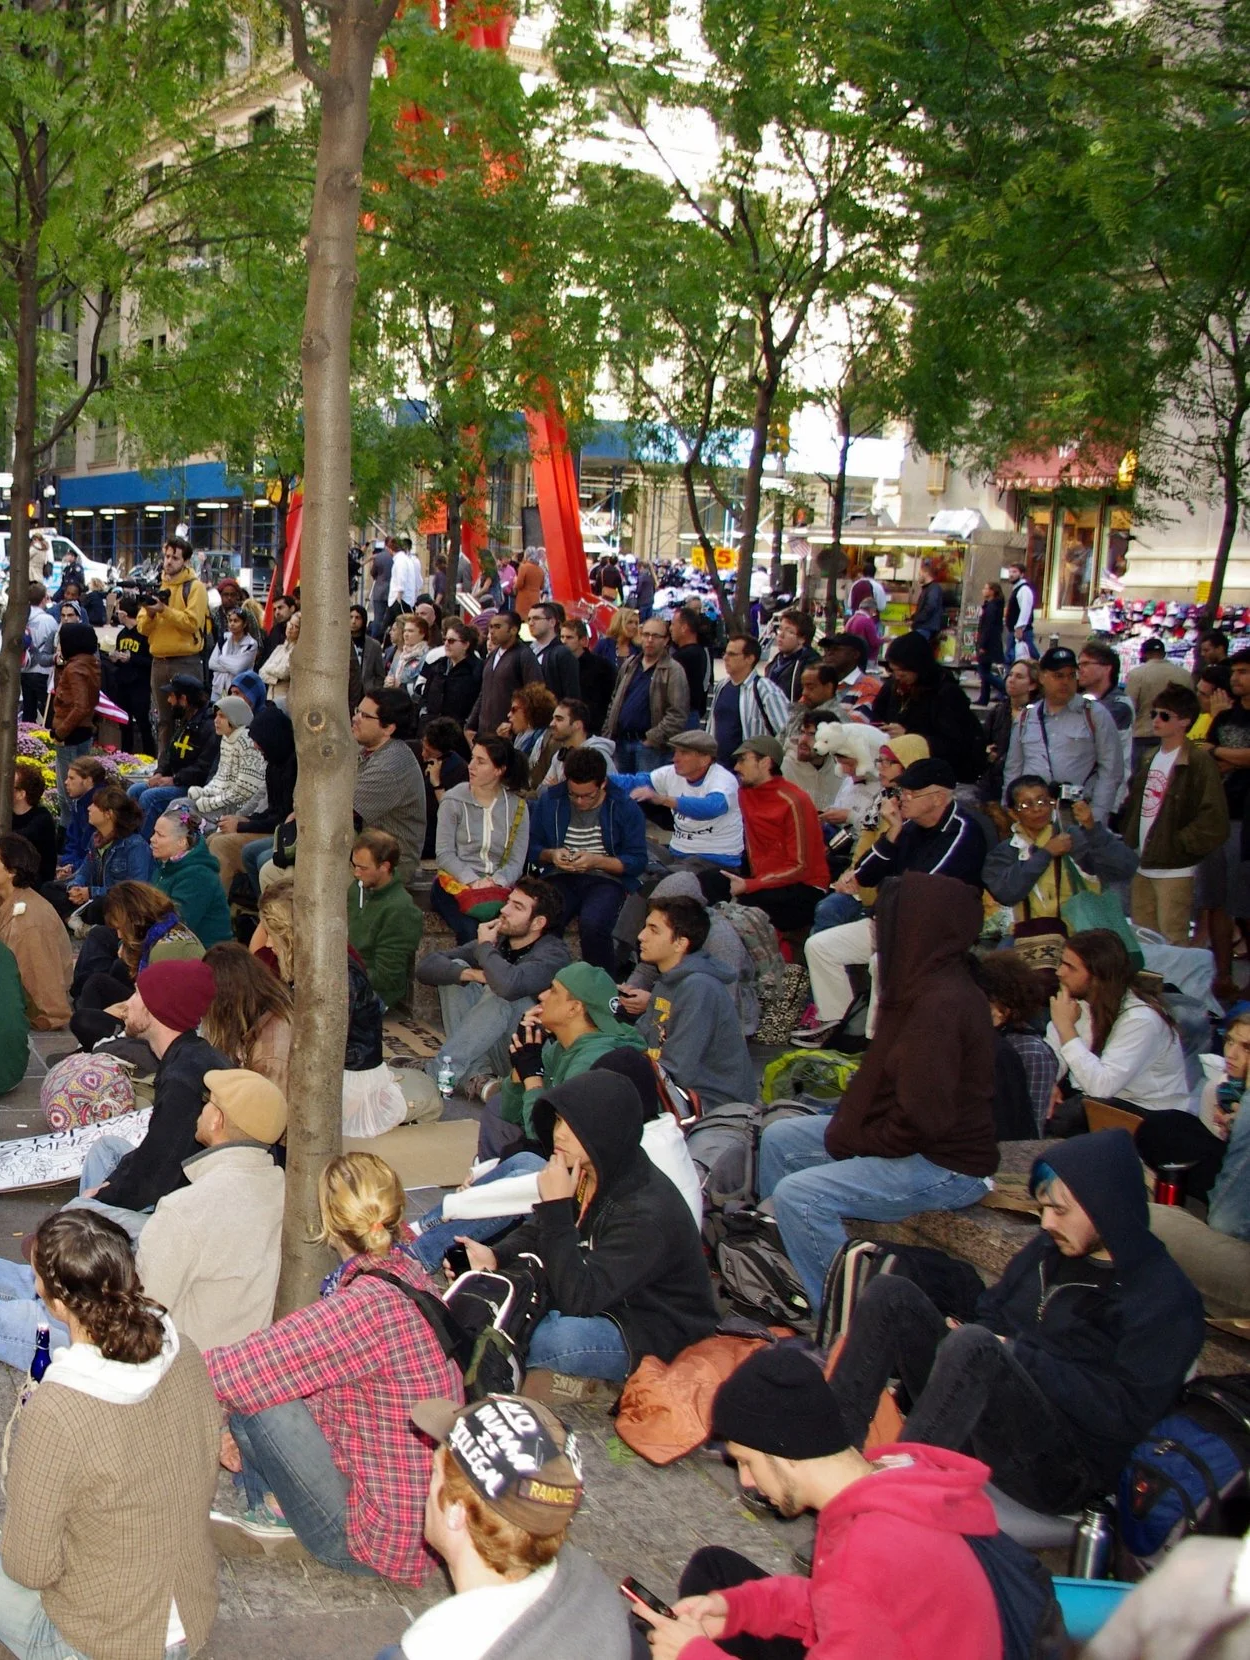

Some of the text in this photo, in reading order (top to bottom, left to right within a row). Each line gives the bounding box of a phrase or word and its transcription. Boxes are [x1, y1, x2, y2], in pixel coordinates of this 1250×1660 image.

[716, 551, 732, 564] 5
[496, 1401, 538, 1438] NO
[474, 1404, 537, 1472] HUMAN
[476, 1430, 501, 1460] IS
